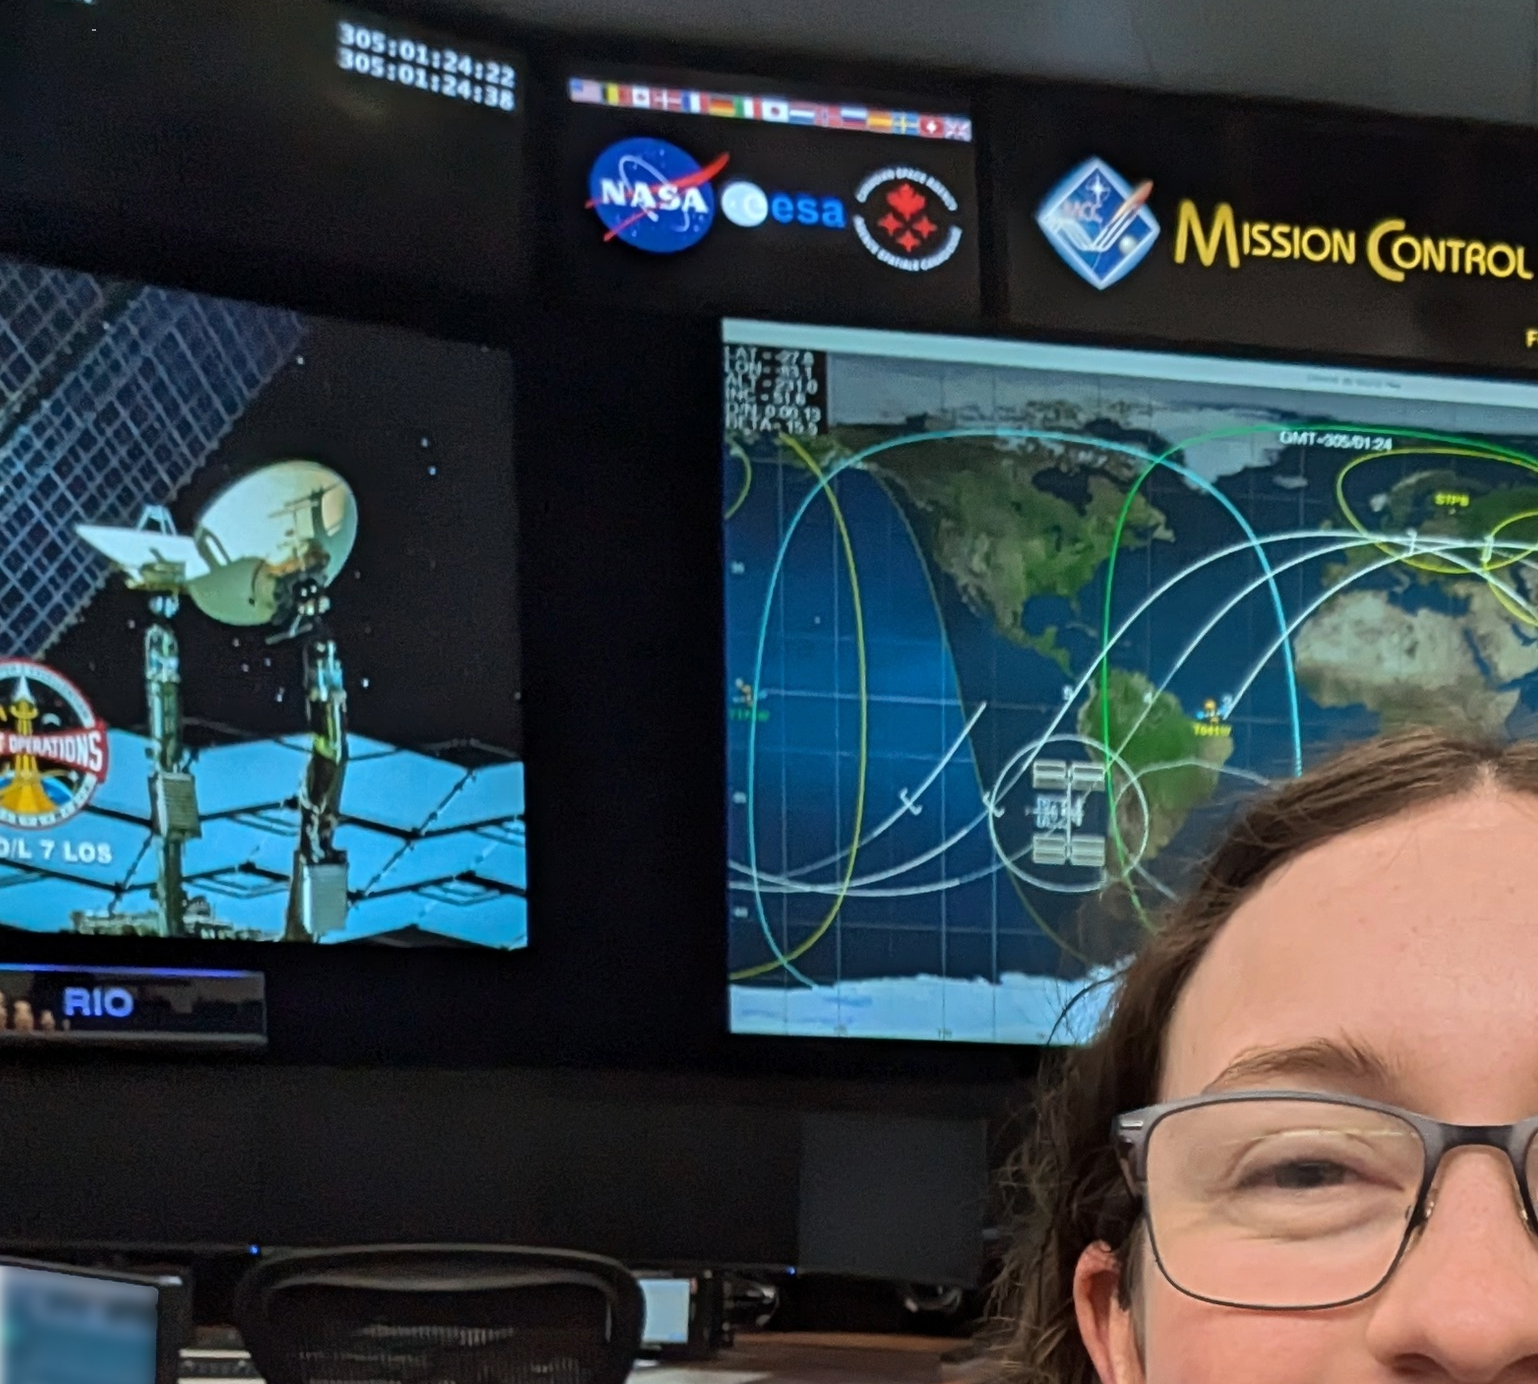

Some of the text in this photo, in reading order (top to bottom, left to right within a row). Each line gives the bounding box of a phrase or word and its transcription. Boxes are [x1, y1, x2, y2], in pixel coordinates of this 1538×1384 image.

[338, 21, 516, 89] 305:01:24:22
[337, 46, 516, 112] 305:01:24:38
[601, 177, 709, 213] NASA
[771, 192, 846, 228] esa
[8, 730, 104, 773] OPERATIONS
[40, 839, 55, 860] 7
[63, 841, 112, 864] LOS
[64, 986, 134, 1017] RIO
